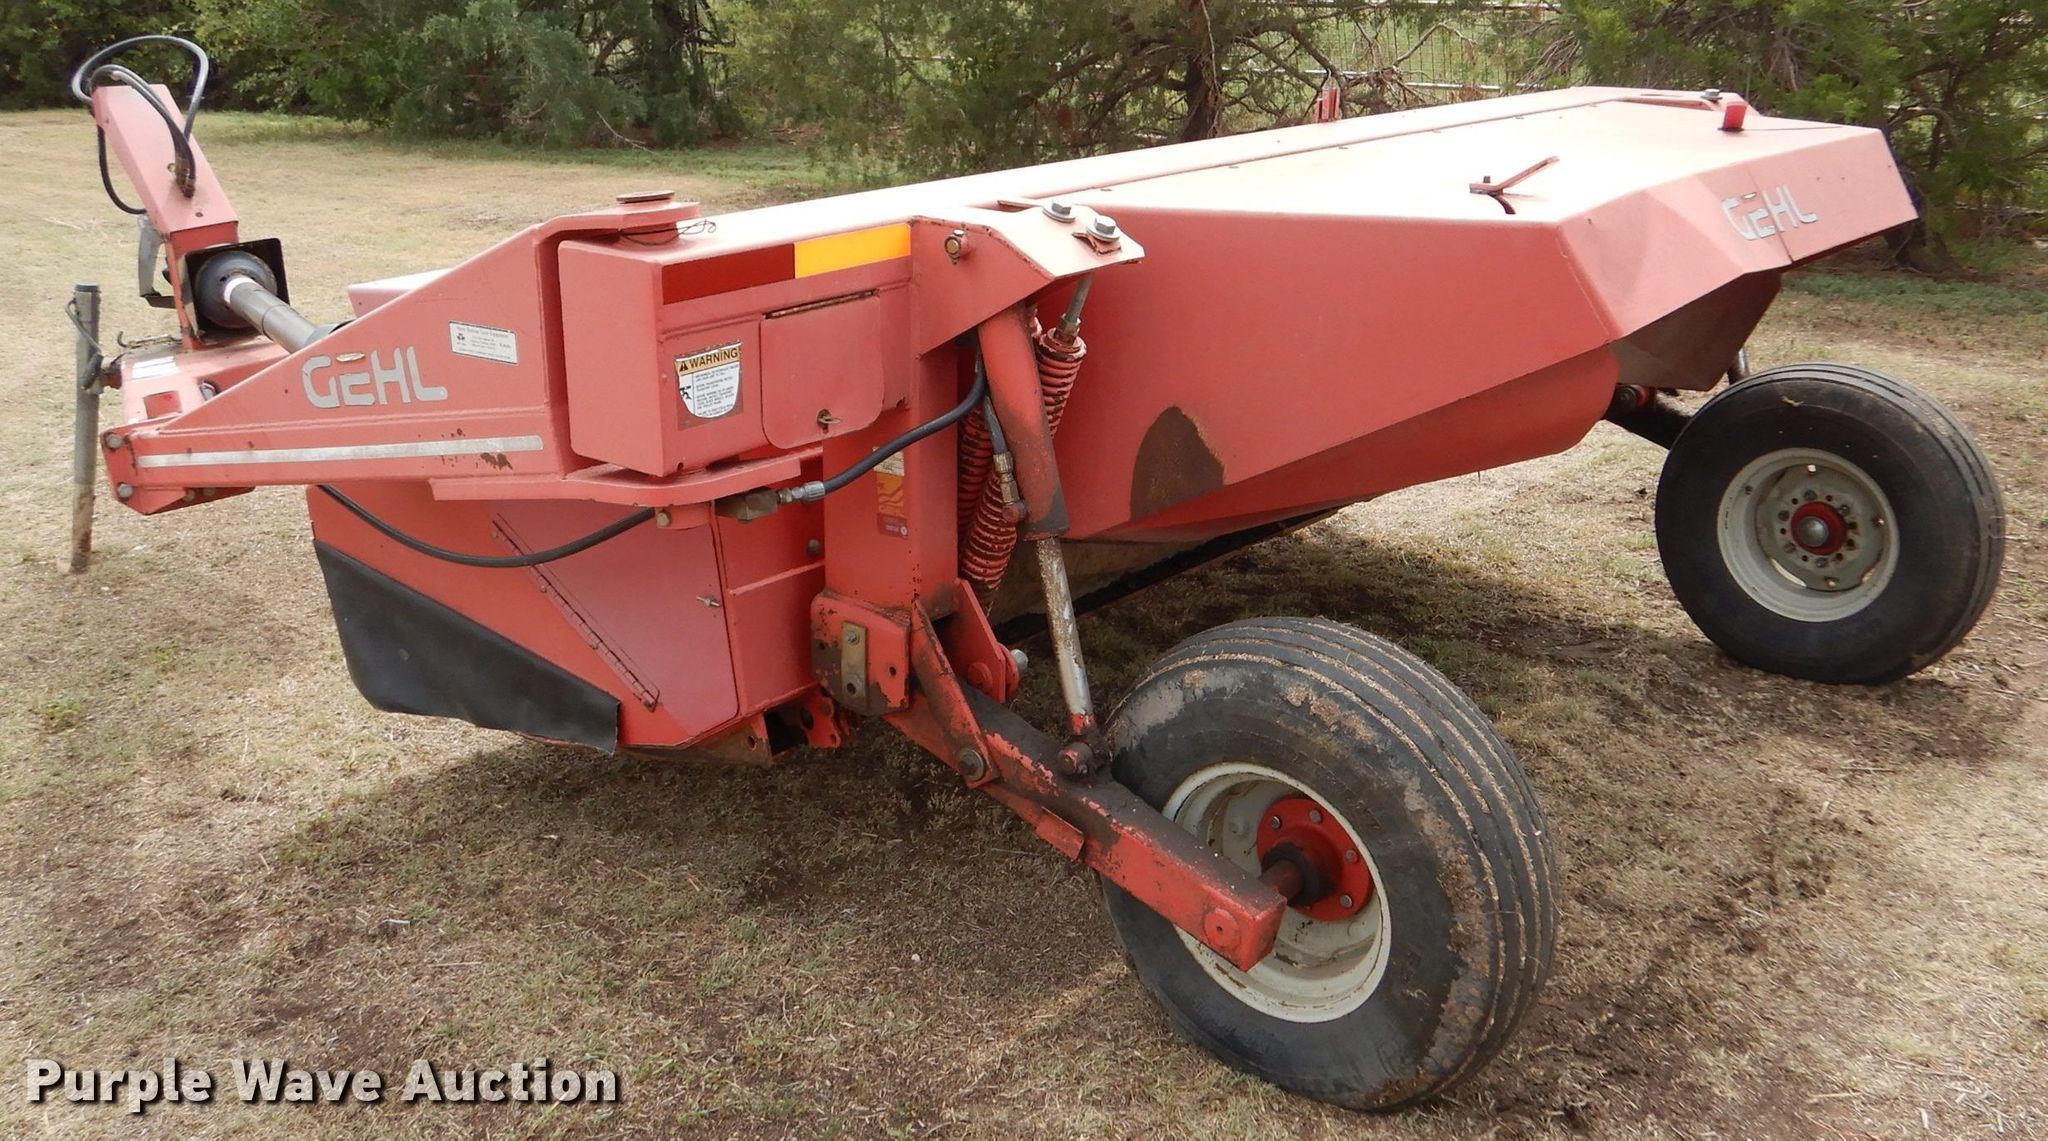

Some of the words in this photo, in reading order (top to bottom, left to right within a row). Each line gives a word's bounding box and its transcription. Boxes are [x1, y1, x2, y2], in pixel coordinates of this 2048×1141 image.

[1721, 184, 1818, 241] GEHL
[301, 346, 448, 408] GEHL
[690, 347, 739, 370] WARNING
